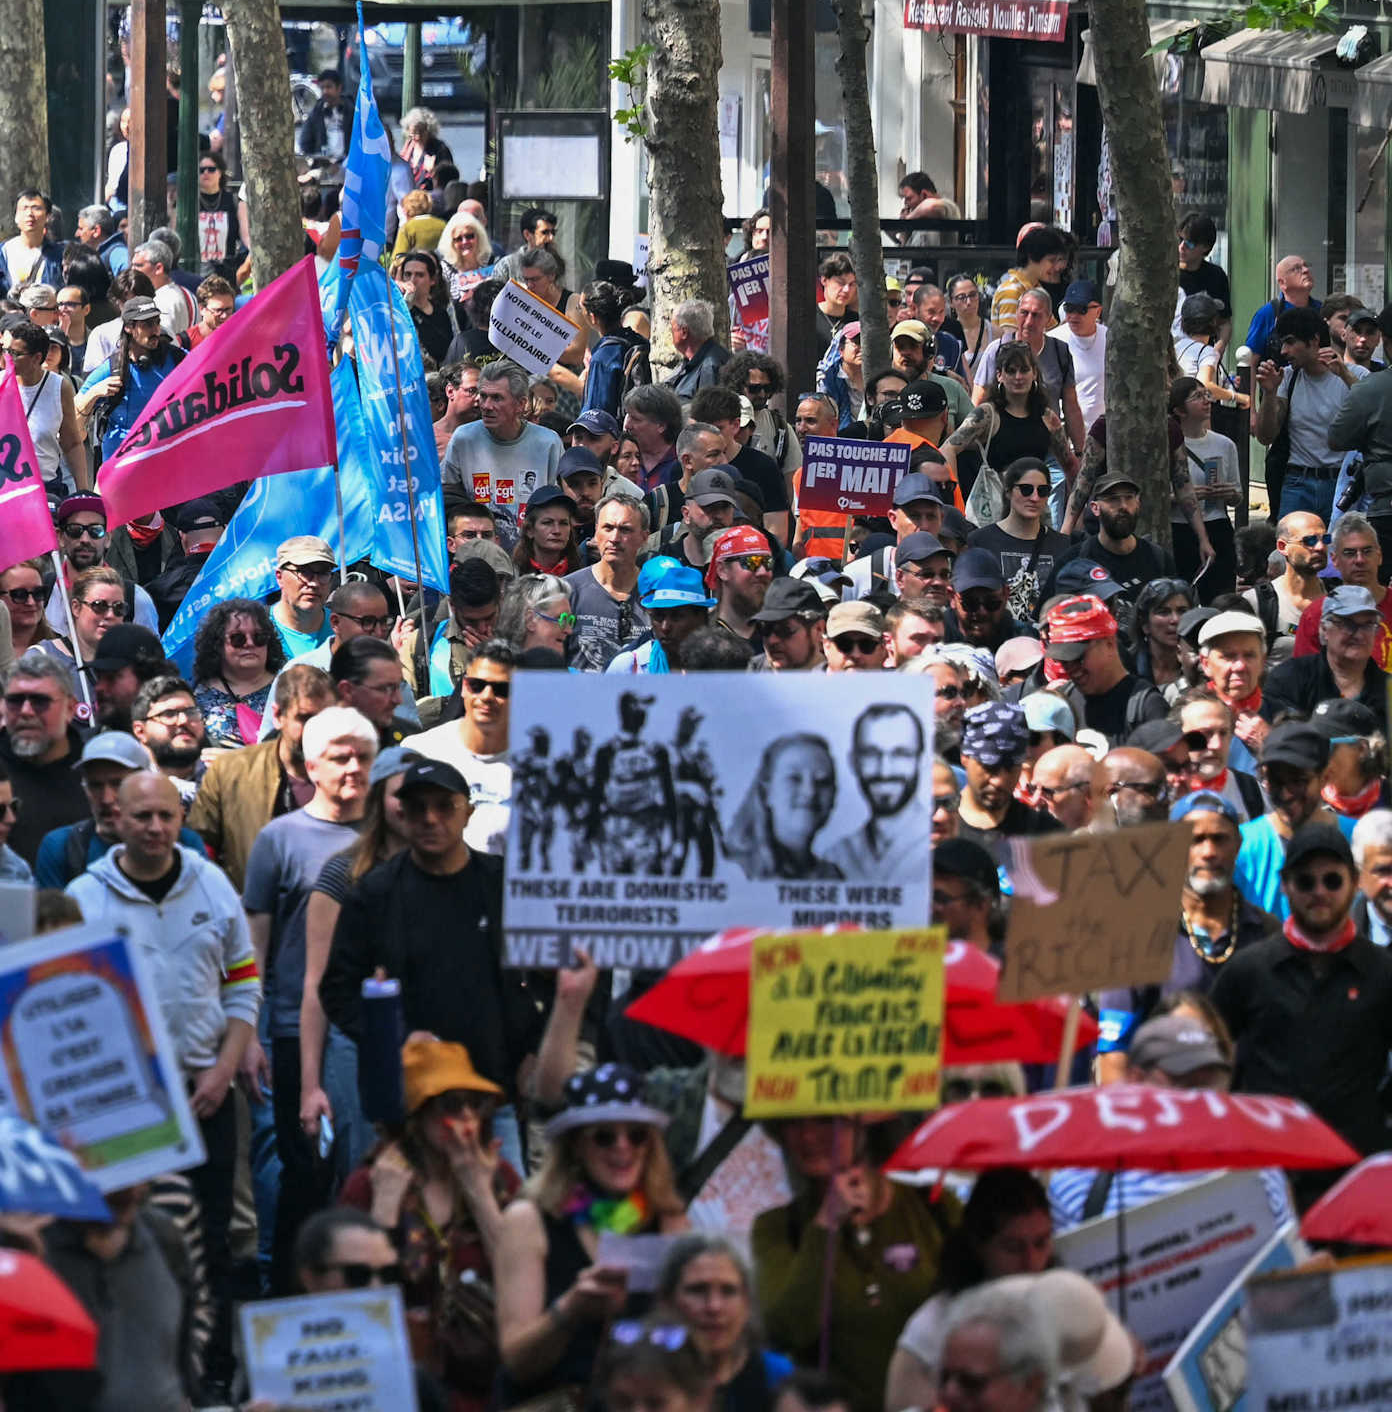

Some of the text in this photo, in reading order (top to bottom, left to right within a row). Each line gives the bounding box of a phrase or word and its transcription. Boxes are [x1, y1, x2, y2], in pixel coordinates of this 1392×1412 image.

[955, 0, 990, 29] Raviolis
[992, 1, 1027, 32] Nouilles
[1027, 5, 1061, 35] Dimsum
[729, 269, 753, 282] PAS
[504, 291, 571, 341] NOTRE PROBLEME
[490, 314, 552, 366] MILLIARDAIRES
[514, 317, 544, 341] C'EST LES
[808, 441, 908, 463] PAS TOUCHE AU
[805, 461, 837, 488] 1ER
[839, 464, 891, 494] MAI
[474, 485, 491, 498] cgt
[496, 485, 514, 499] cgt
[1046, 830, 1173, 899] TAX
[509, 879, 727, 903] THESE ARE DOMESTIC
[776, 885, 903, 906] THESE WERE
[555, 904, 680, 926] TERRORISTS
[503, 934, 560, 966] WE
[20, 983, 103, 1023] UTILISER
